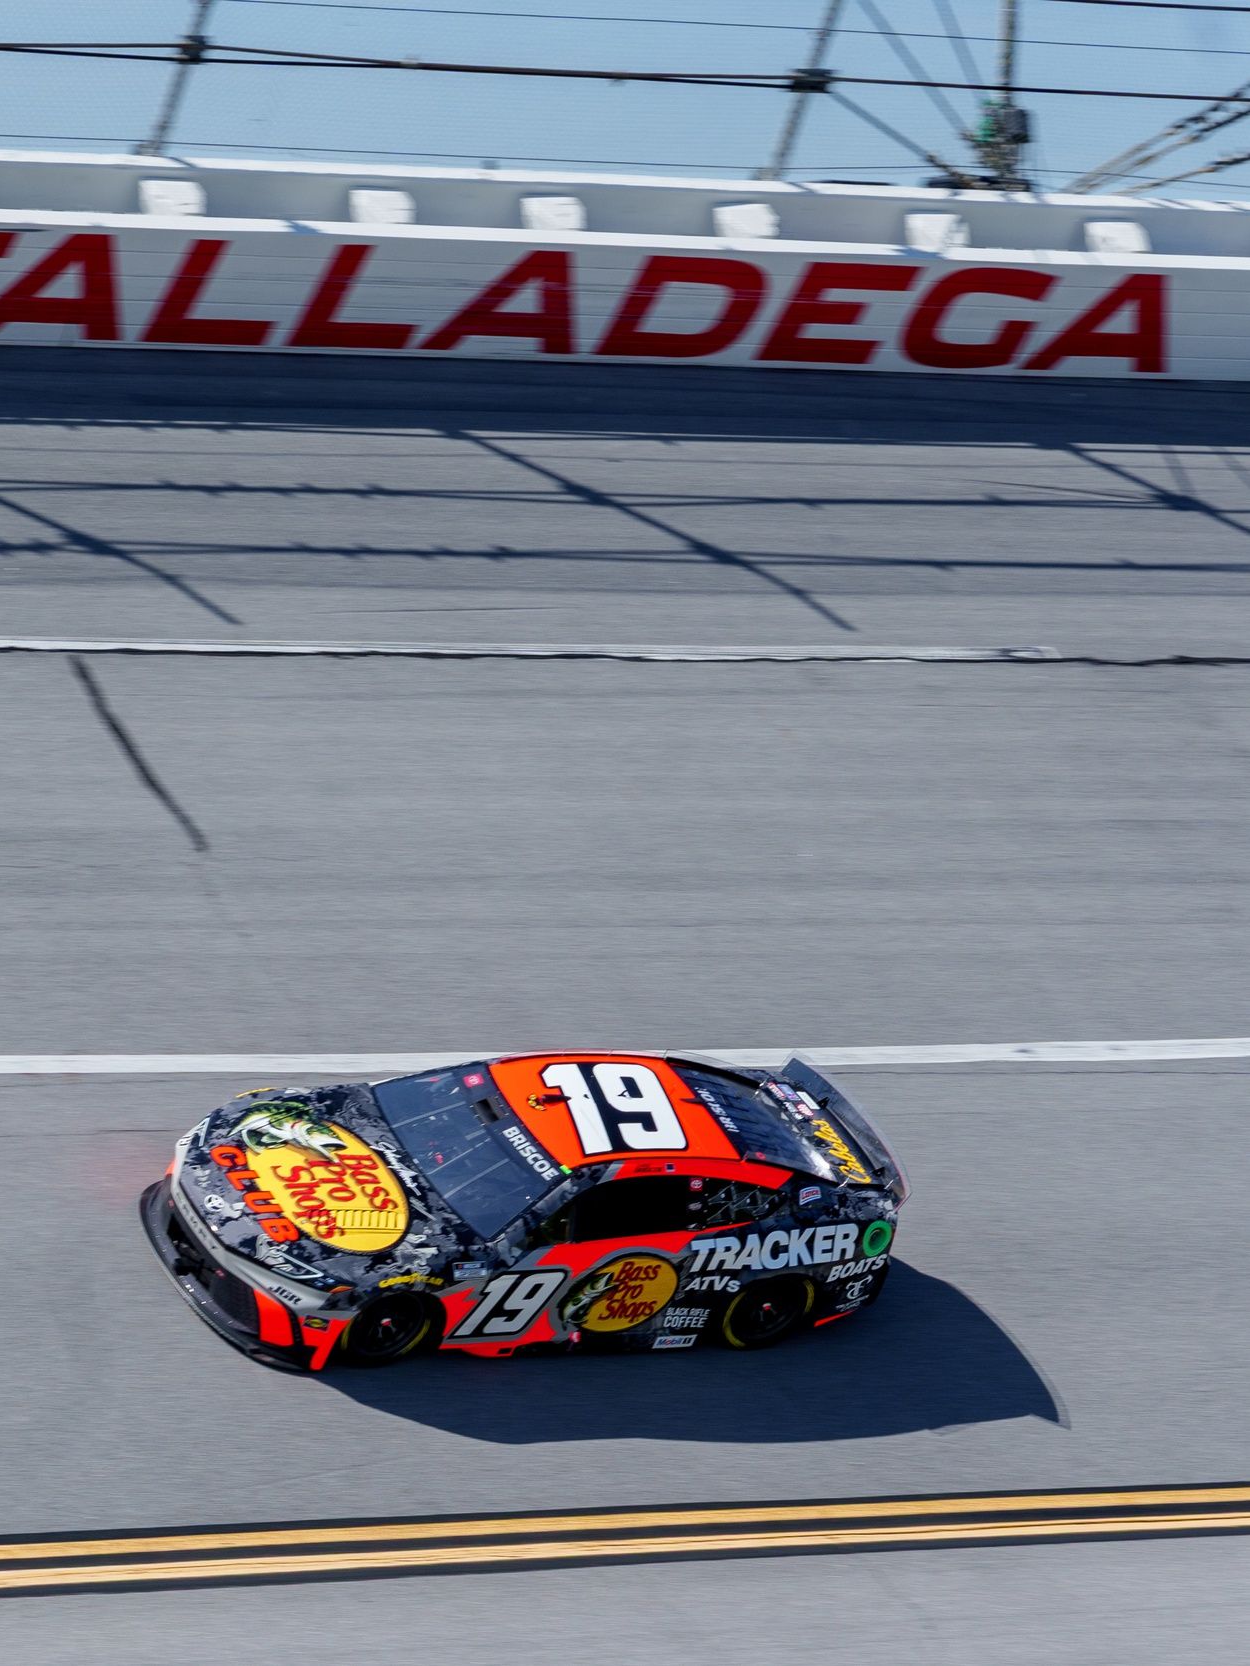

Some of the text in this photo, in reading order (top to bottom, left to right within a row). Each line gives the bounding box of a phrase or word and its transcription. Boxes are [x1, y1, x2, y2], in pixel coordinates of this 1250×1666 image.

[541, 1063, 688, 1156] 19
[502, 1126, 560, 1181] BRISCOE
[210, 1145, 299, 1243] CLUB
[270, 1165, 346, 1239] Shops
[305, 1159, 357, 1202] Pro
[334, 1153, 399, 1210] Bass
[690, 1223, 859, 1273] TRACKER
[825, 1254, 888, 1283] BOATS
[607, 1281, 644, 1300] Pro
[614, 1261, 662, 1281] Bass
[684, 1275, 742, 1293] ATVs
[453, 1271, 566, 1335] 19
[598, 1300, 658, 1323] Shops
[663, 1316, 709, 1328] COFFEE
[666, 1307, 690, 1316] BLACK
